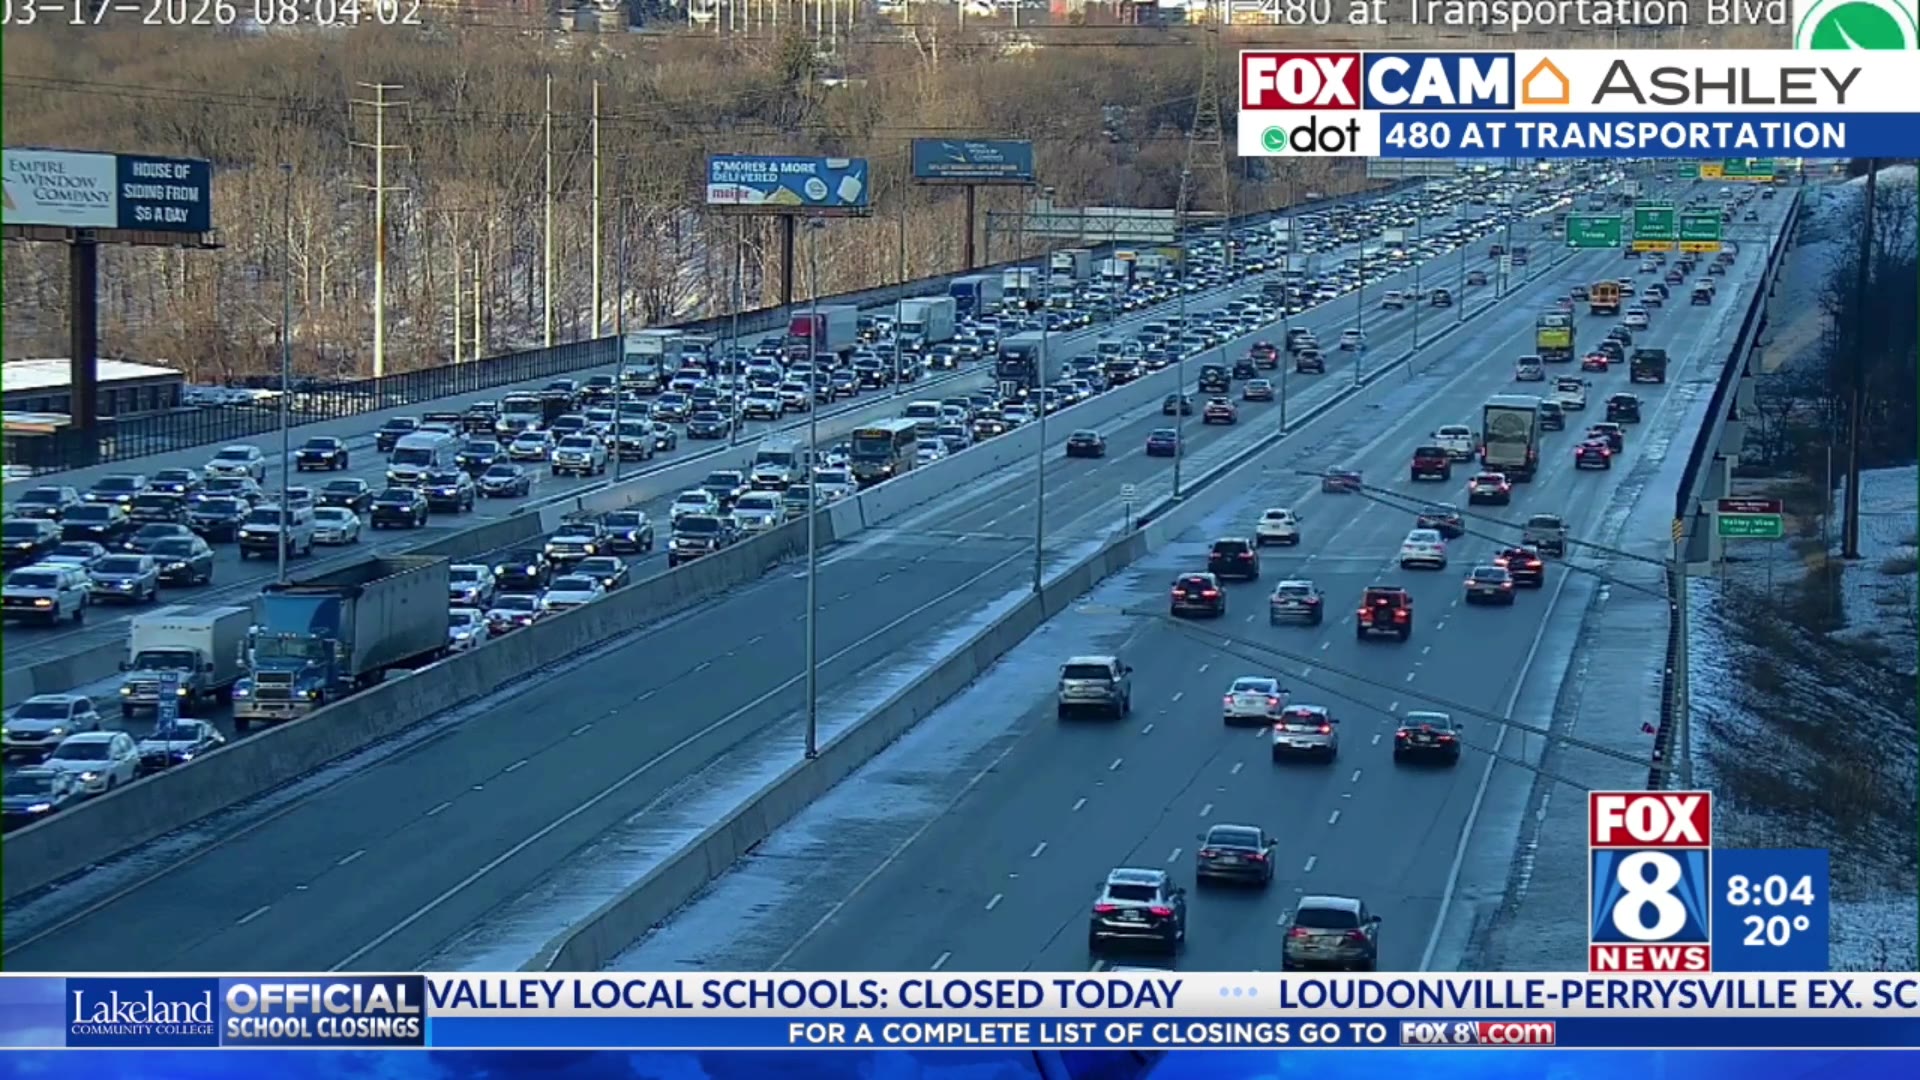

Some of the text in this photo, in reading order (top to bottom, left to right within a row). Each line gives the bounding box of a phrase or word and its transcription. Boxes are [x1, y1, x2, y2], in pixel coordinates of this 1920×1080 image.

[9, 159, 66, 174] EMPIRE
[133, 162, 191, 178] HOUSE OF
[769, 162, 778, 172] &
[781, 163, 816, 173] MORE
[21, 173, 98, 188] WINDOW
[712, 172, 777, 182] DELIVERED
[33, 187, 112, 202] COMPANY
[123, 183, 199, 202] SIDING FROM
[154, 208, 163, 221] A
[164, 208, 188, 222] DAY
